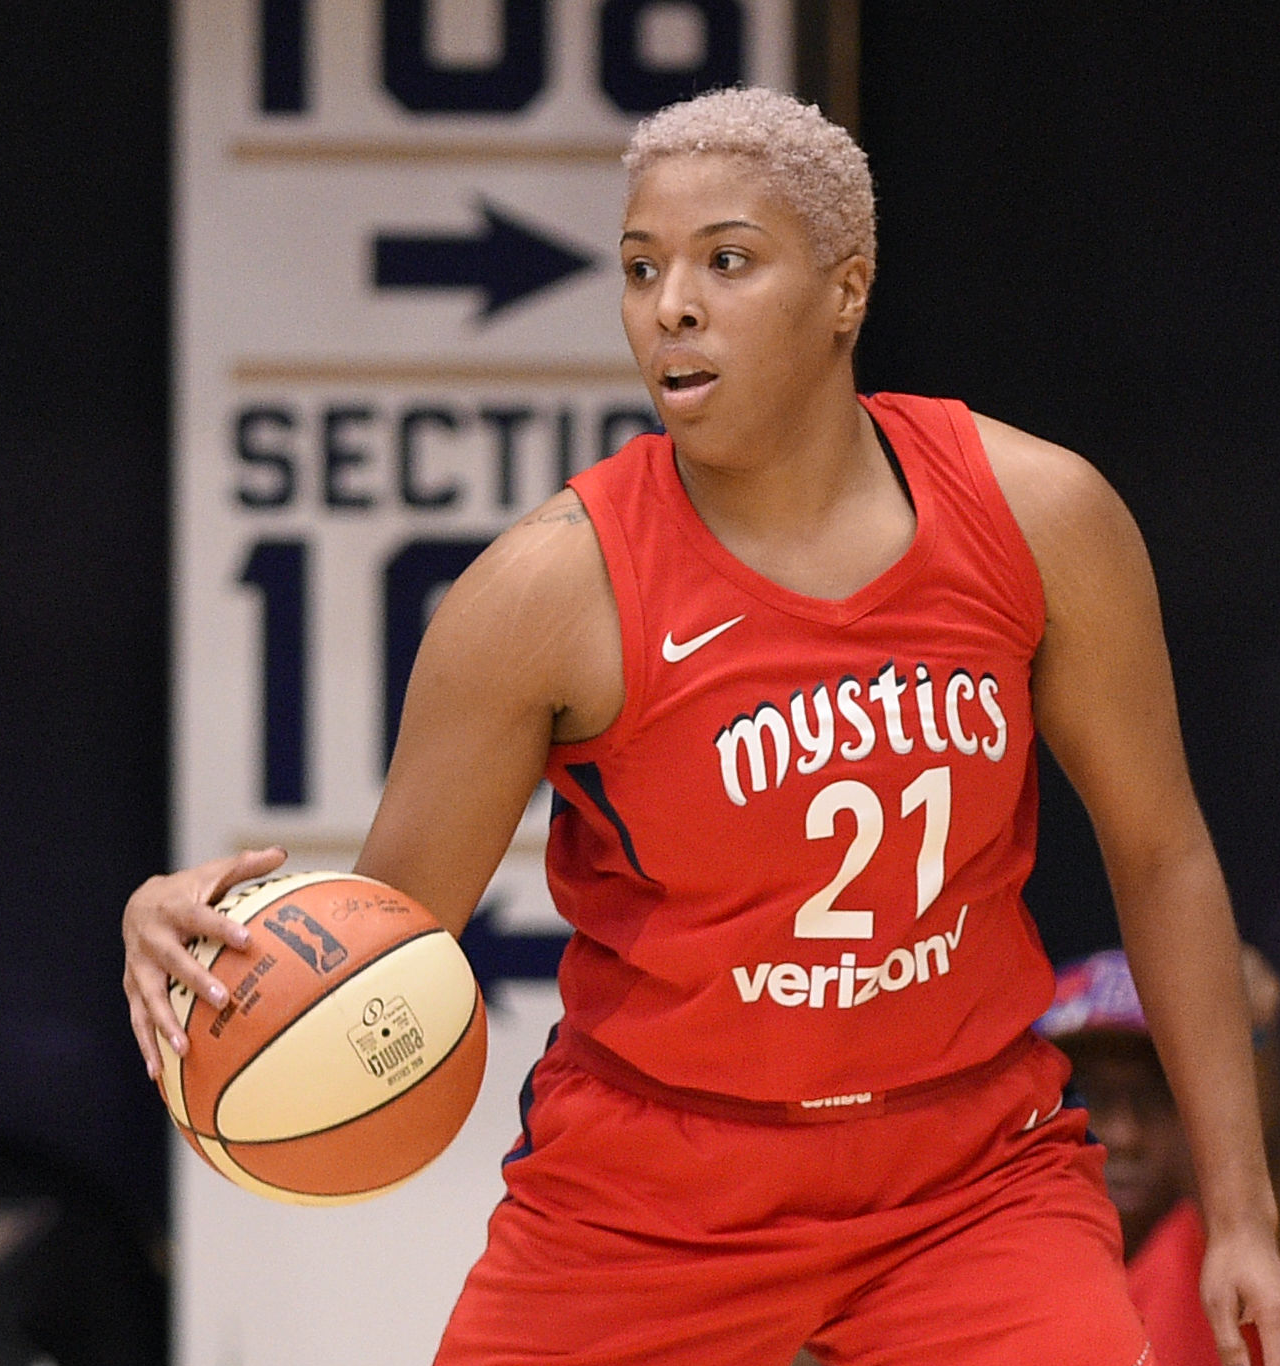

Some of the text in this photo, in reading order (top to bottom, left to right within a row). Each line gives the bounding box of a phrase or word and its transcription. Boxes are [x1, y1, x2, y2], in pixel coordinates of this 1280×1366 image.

[715, 658, 1008, 806] mystics
[794, 766, 951, 940] 21
[732, 932, 950, 1009] verizon
